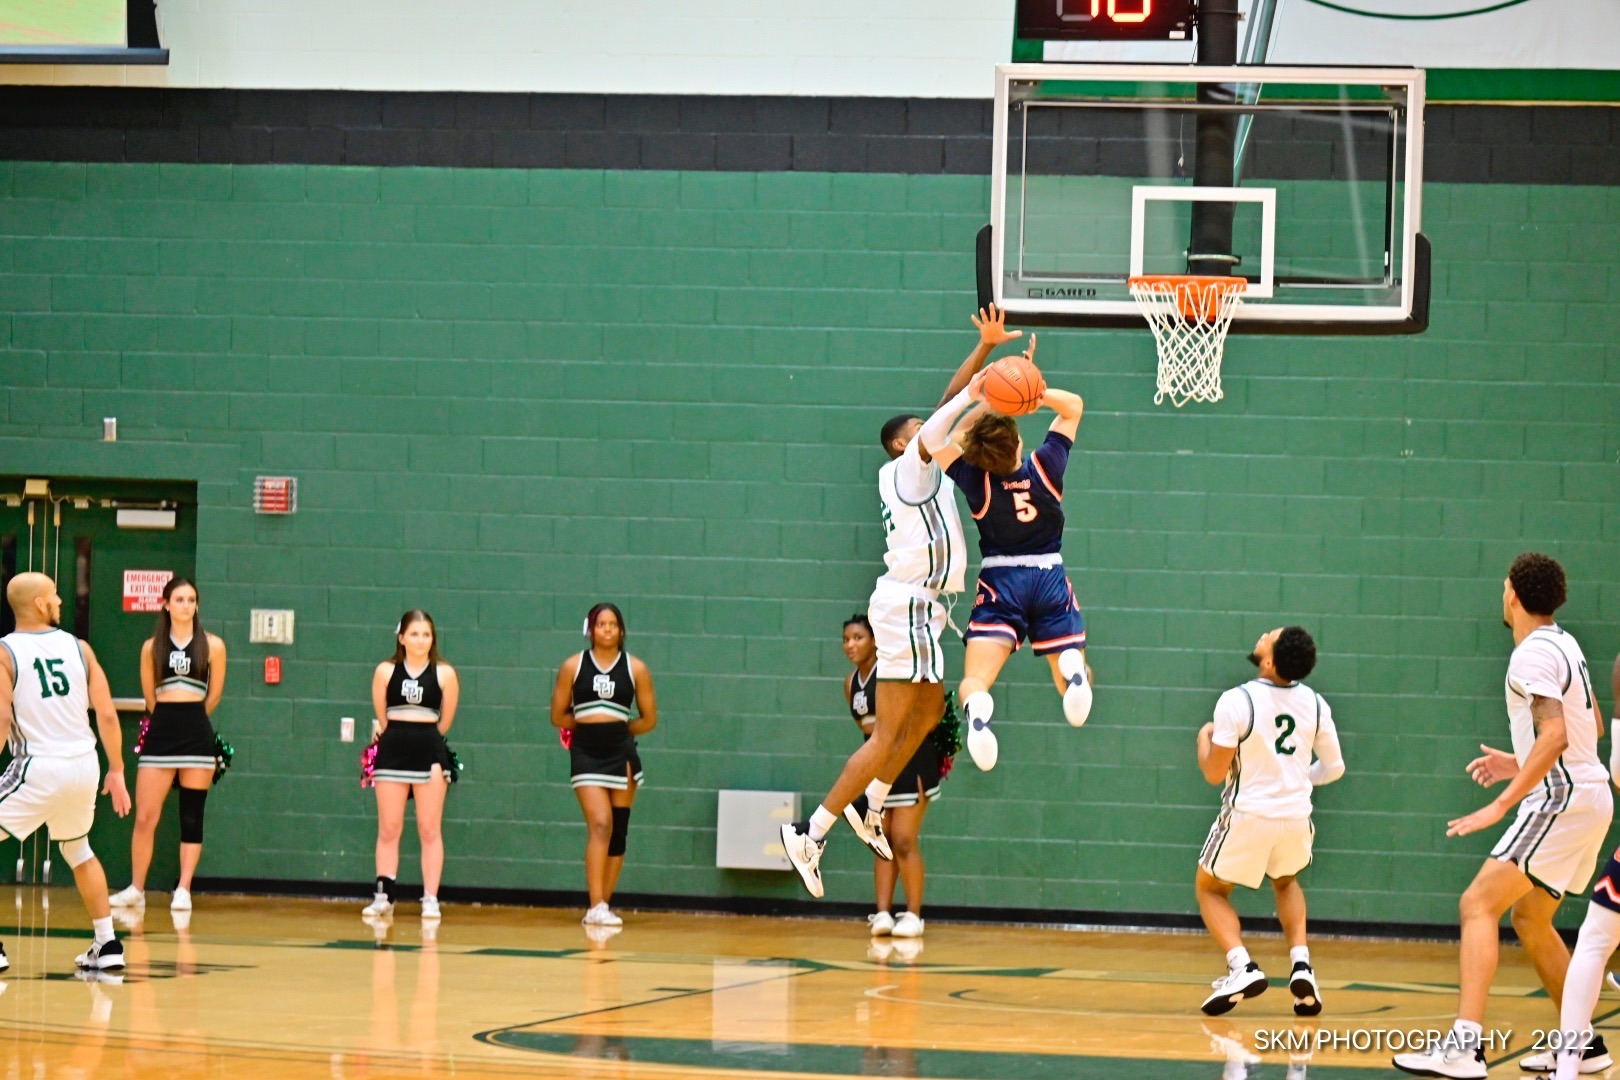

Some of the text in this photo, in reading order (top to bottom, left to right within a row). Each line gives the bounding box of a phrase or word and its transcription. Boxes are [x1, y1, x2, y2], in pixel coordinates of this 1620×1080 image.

[1012, 491, 1038, 523] 5
[126, 574, 170, 583] EMERGENCY
[130, 585, 146, 593] EXIT
[33, 656, 70, 699] 15
[1274, 713, 1297, 756] 2
